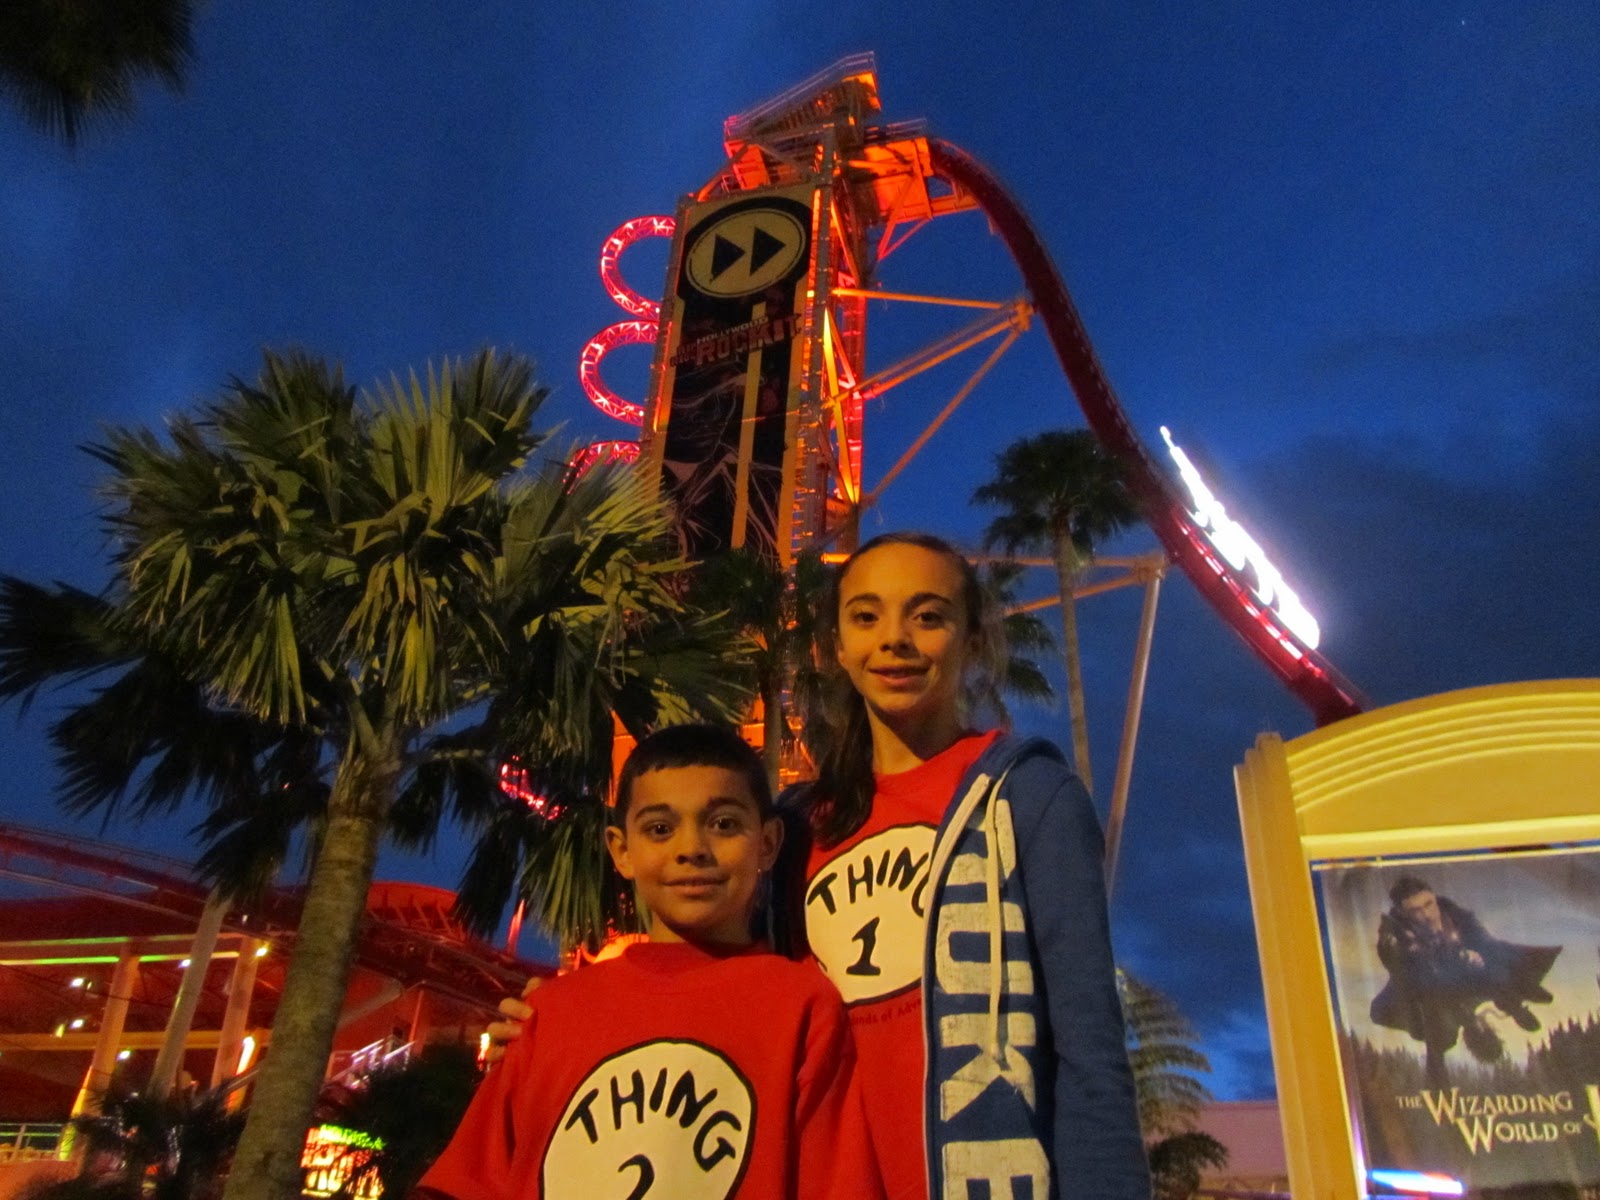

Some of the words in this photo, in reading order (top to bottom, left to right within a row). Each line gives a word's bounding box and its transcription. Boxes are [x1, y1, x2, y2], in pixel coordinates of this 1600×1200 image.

[695, 314, 801, 366] ROCKIT
[697, 316, 769, 344] HOLLYWOOD
[846, 916, 881, 976] 1
[564, 1067, 742, 1172] THING
[1396, 1096, 1422, 1109] THE
[1456, 1115, 1558, 1155] WORLD
[617, 1154, 655, 1200] 2
